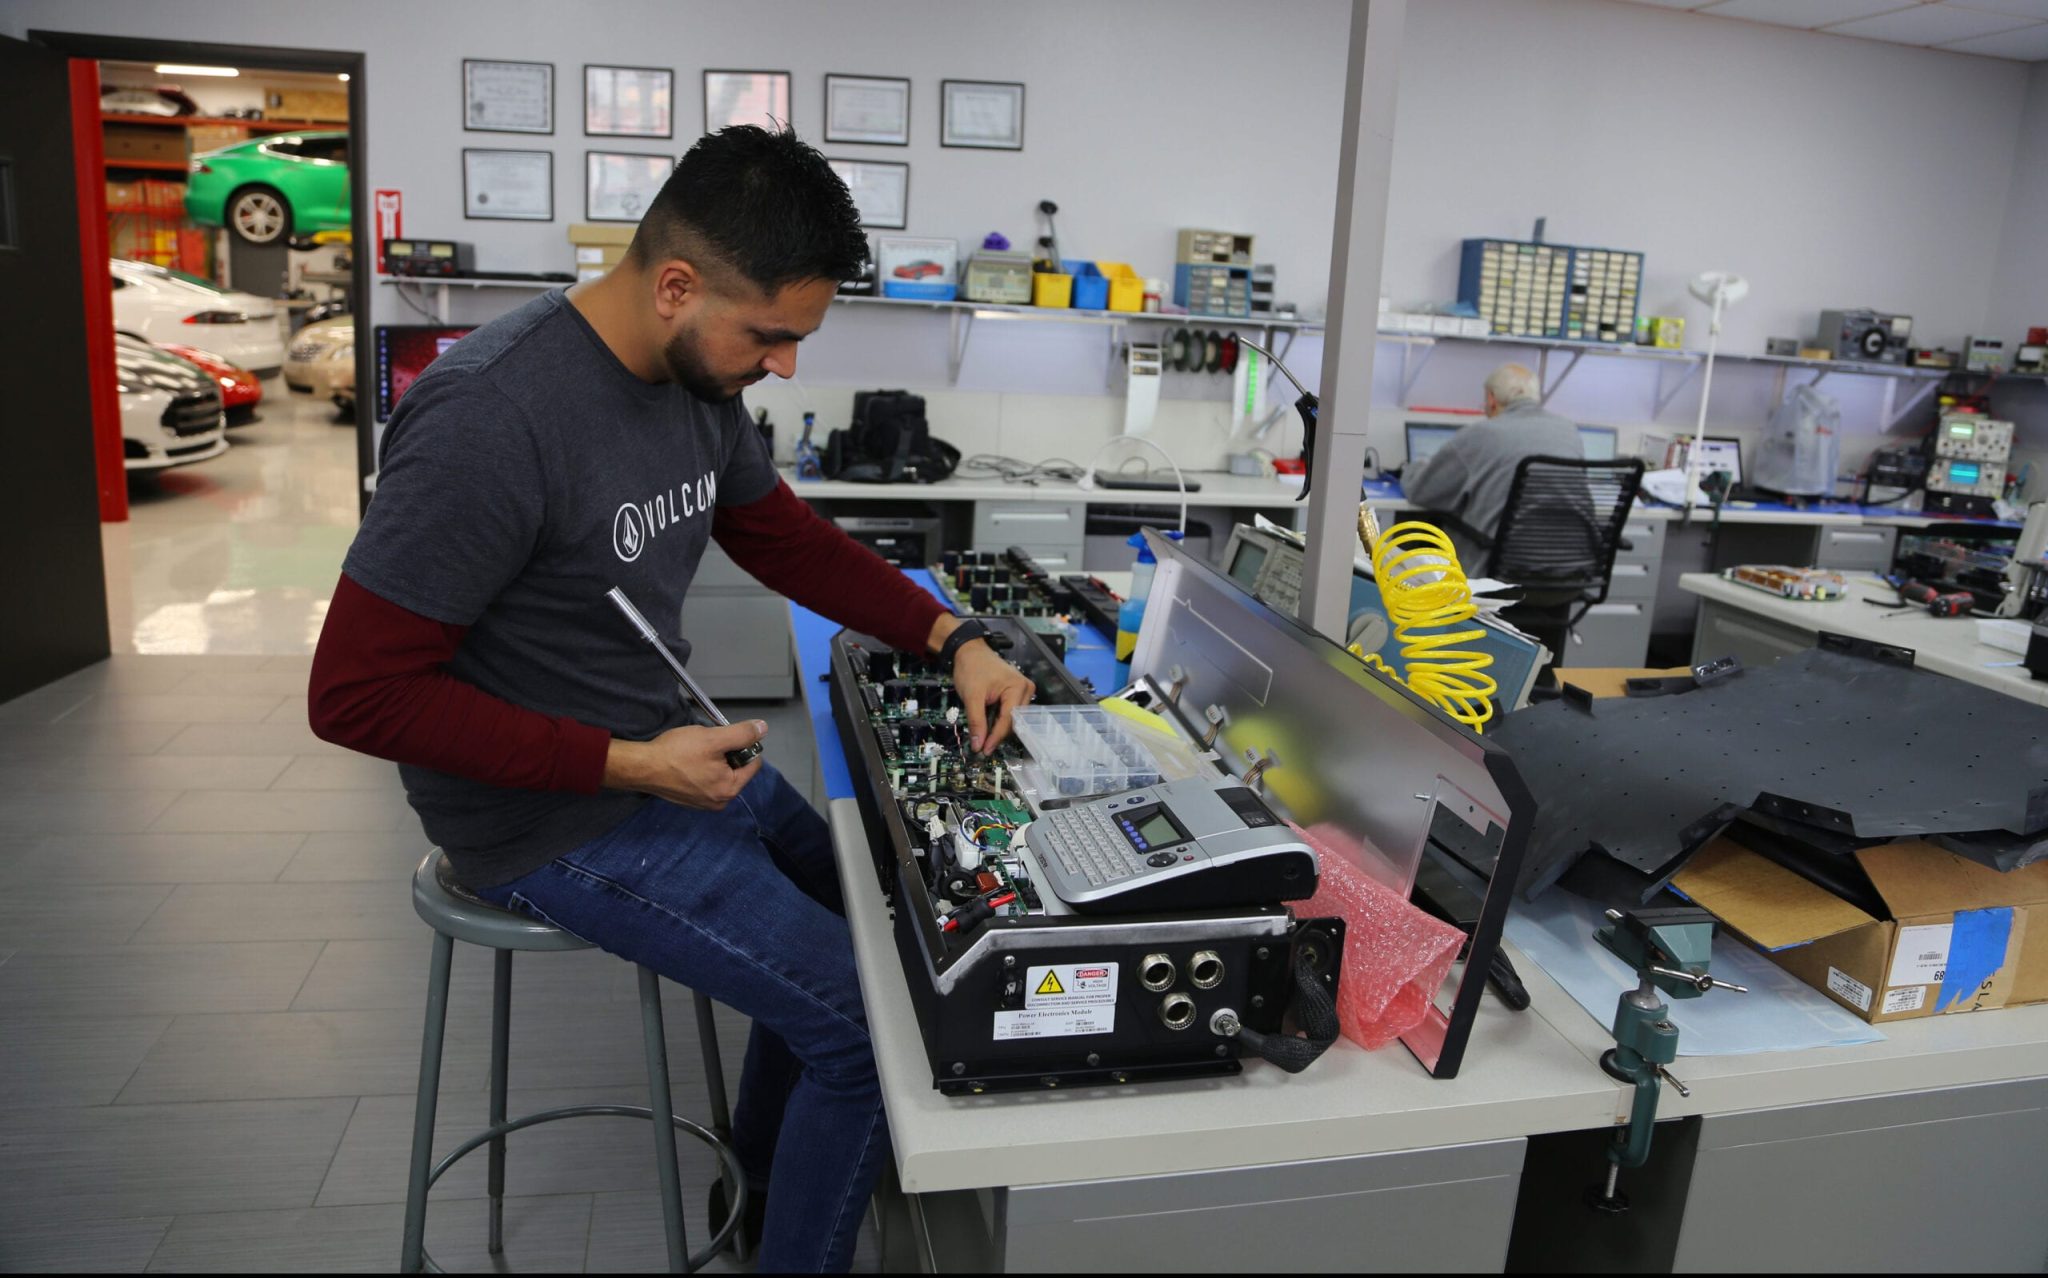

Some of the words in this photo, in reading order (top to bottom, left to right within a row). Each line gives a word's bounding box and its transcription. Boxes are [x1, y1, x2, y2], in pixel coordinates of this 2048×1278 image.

[644, 471, 716, 538] VOLCOM
[1079, 970, 1105, 978] DANGER
[1972, 971, 1995, 1011] SLA
